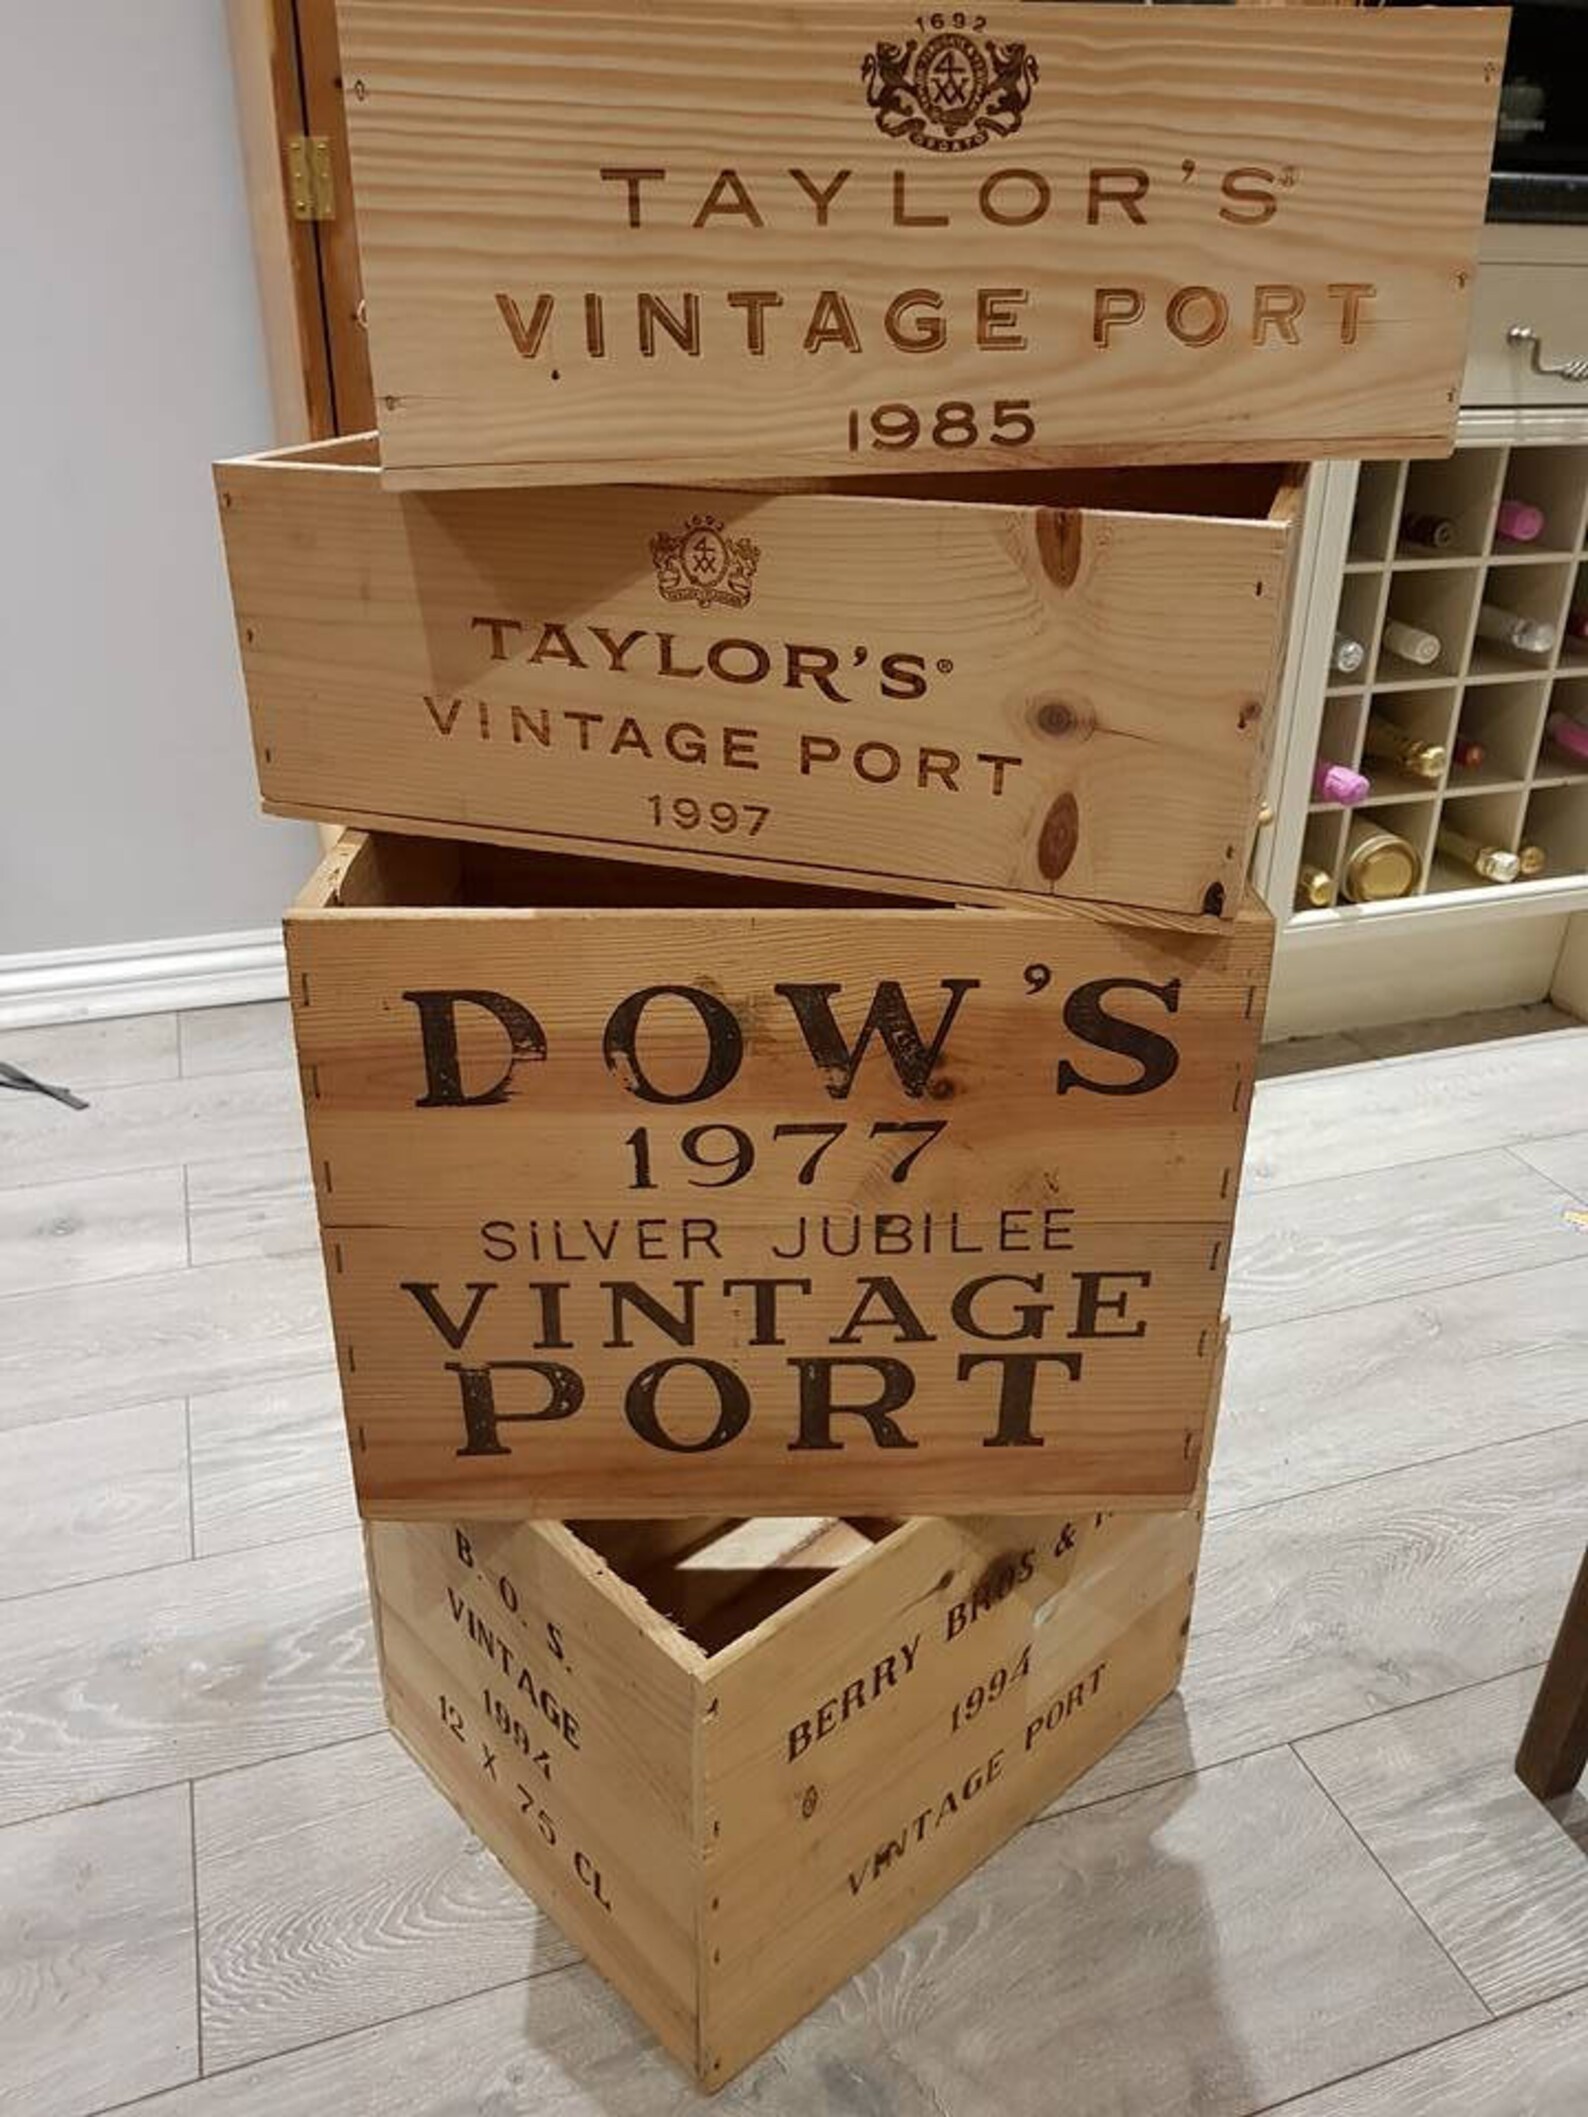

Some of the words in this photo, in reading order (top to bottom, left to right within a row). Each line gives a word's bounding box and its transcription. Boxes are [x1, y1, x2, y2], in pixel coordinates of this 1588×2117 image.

[915, 12, 987, 33] 1692
[495, 287, 1029, 358] VINTAGE
[1093, 283, 1378, 349] PORT
[848, 399, 1035, 452] 1985
[423, 696, 760, 771] VINTAGE
[800, 735, 1023, 797] PORT
[647, 795, 772, 837] 1997
[402, 962, 1183, 1108] DOW'S
[625, 1119, 949, 1190] 1977
[772, 1208, 1076, 1260] JUBILEE
[400, 1270, 1153, 1350] VINTAGE
[444, 1352, 1083, 1457] PORT
[447, 1586, 581, 1751] VINTAGE
[786, 1634, 922, 1764] BERRY
[1053, 1521, 1077, 1558] &
[950, 1642, 1034, 1734] 1994
[483, 1689, 553, 1781] 1994
[848, 1748, 1006, 1897] VINTAGE
[1023, 1663, 1107, 1752] PORT
[438, 1695, 466, 1743] 12
[516, 1783, 556, 1846] 75
[573, 1852, 612, 1913] CL
